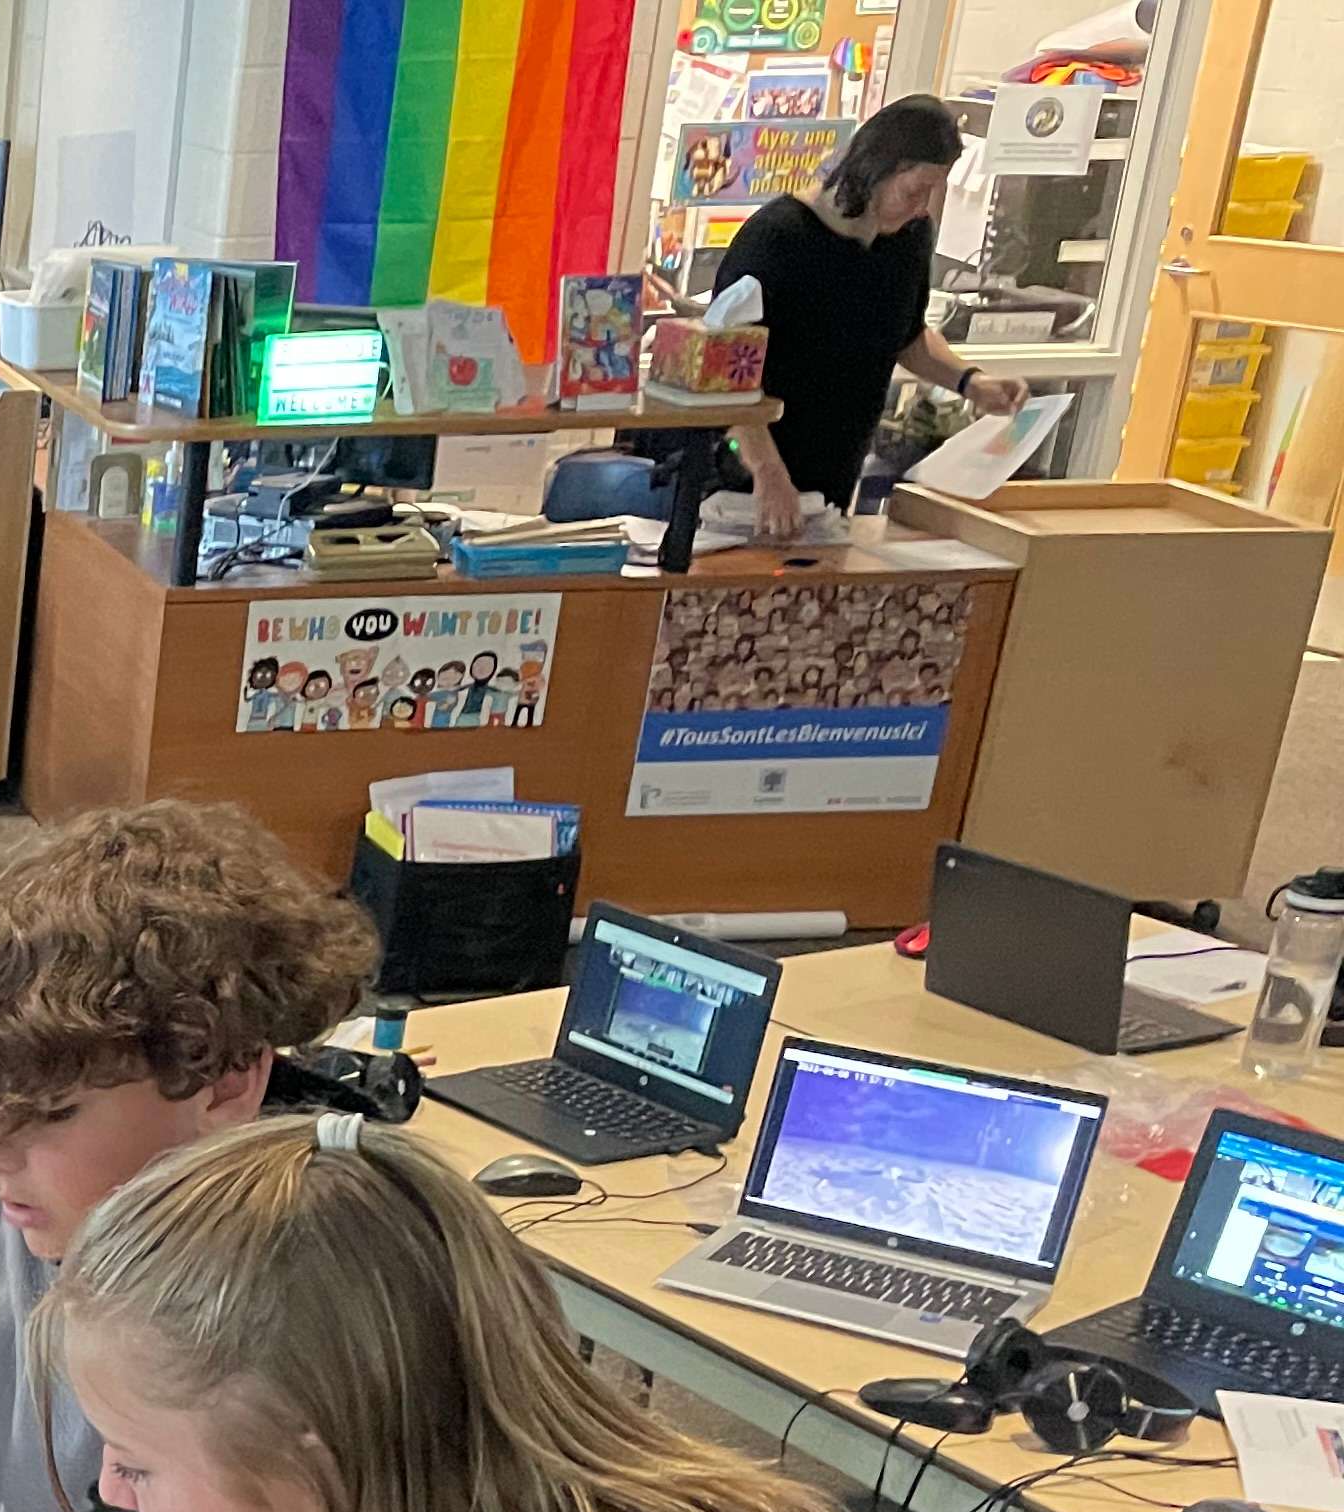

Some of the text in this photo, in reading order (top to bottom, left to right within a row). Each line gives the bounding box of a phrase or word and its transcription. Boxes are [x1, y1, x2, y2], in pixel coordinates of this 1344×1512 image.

[257, 608, 543, 642] BE WHO YOU WANT TO BE!
